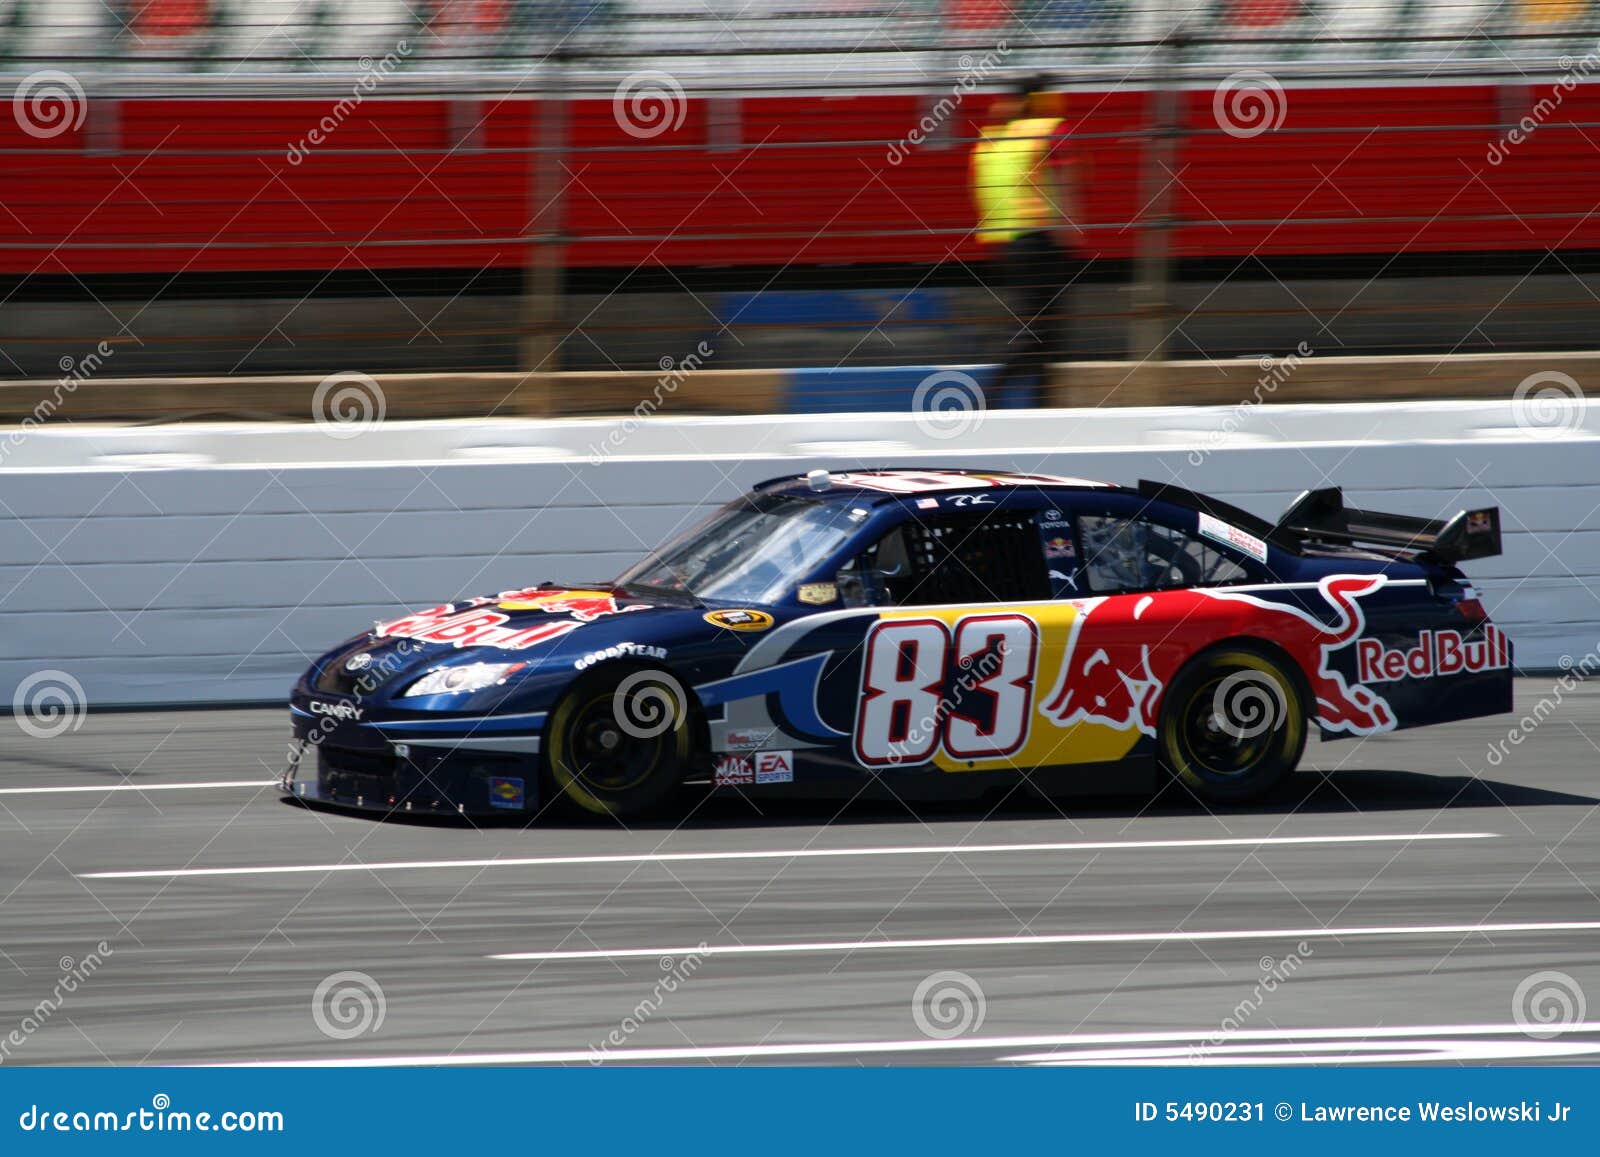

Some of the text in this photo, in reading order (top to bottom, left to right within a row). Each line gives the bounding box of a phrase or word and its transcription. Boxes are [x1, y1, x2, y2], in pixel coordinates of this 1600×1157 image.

[1039, 521, 1070, 529] TOYOTA
[574, 642, 668, 670] GOODYEAR
[1356, 624, 1509, 684] Red Bull
[853, 613, 1040, 769] 83
[759, 754, 790, 773] EA
